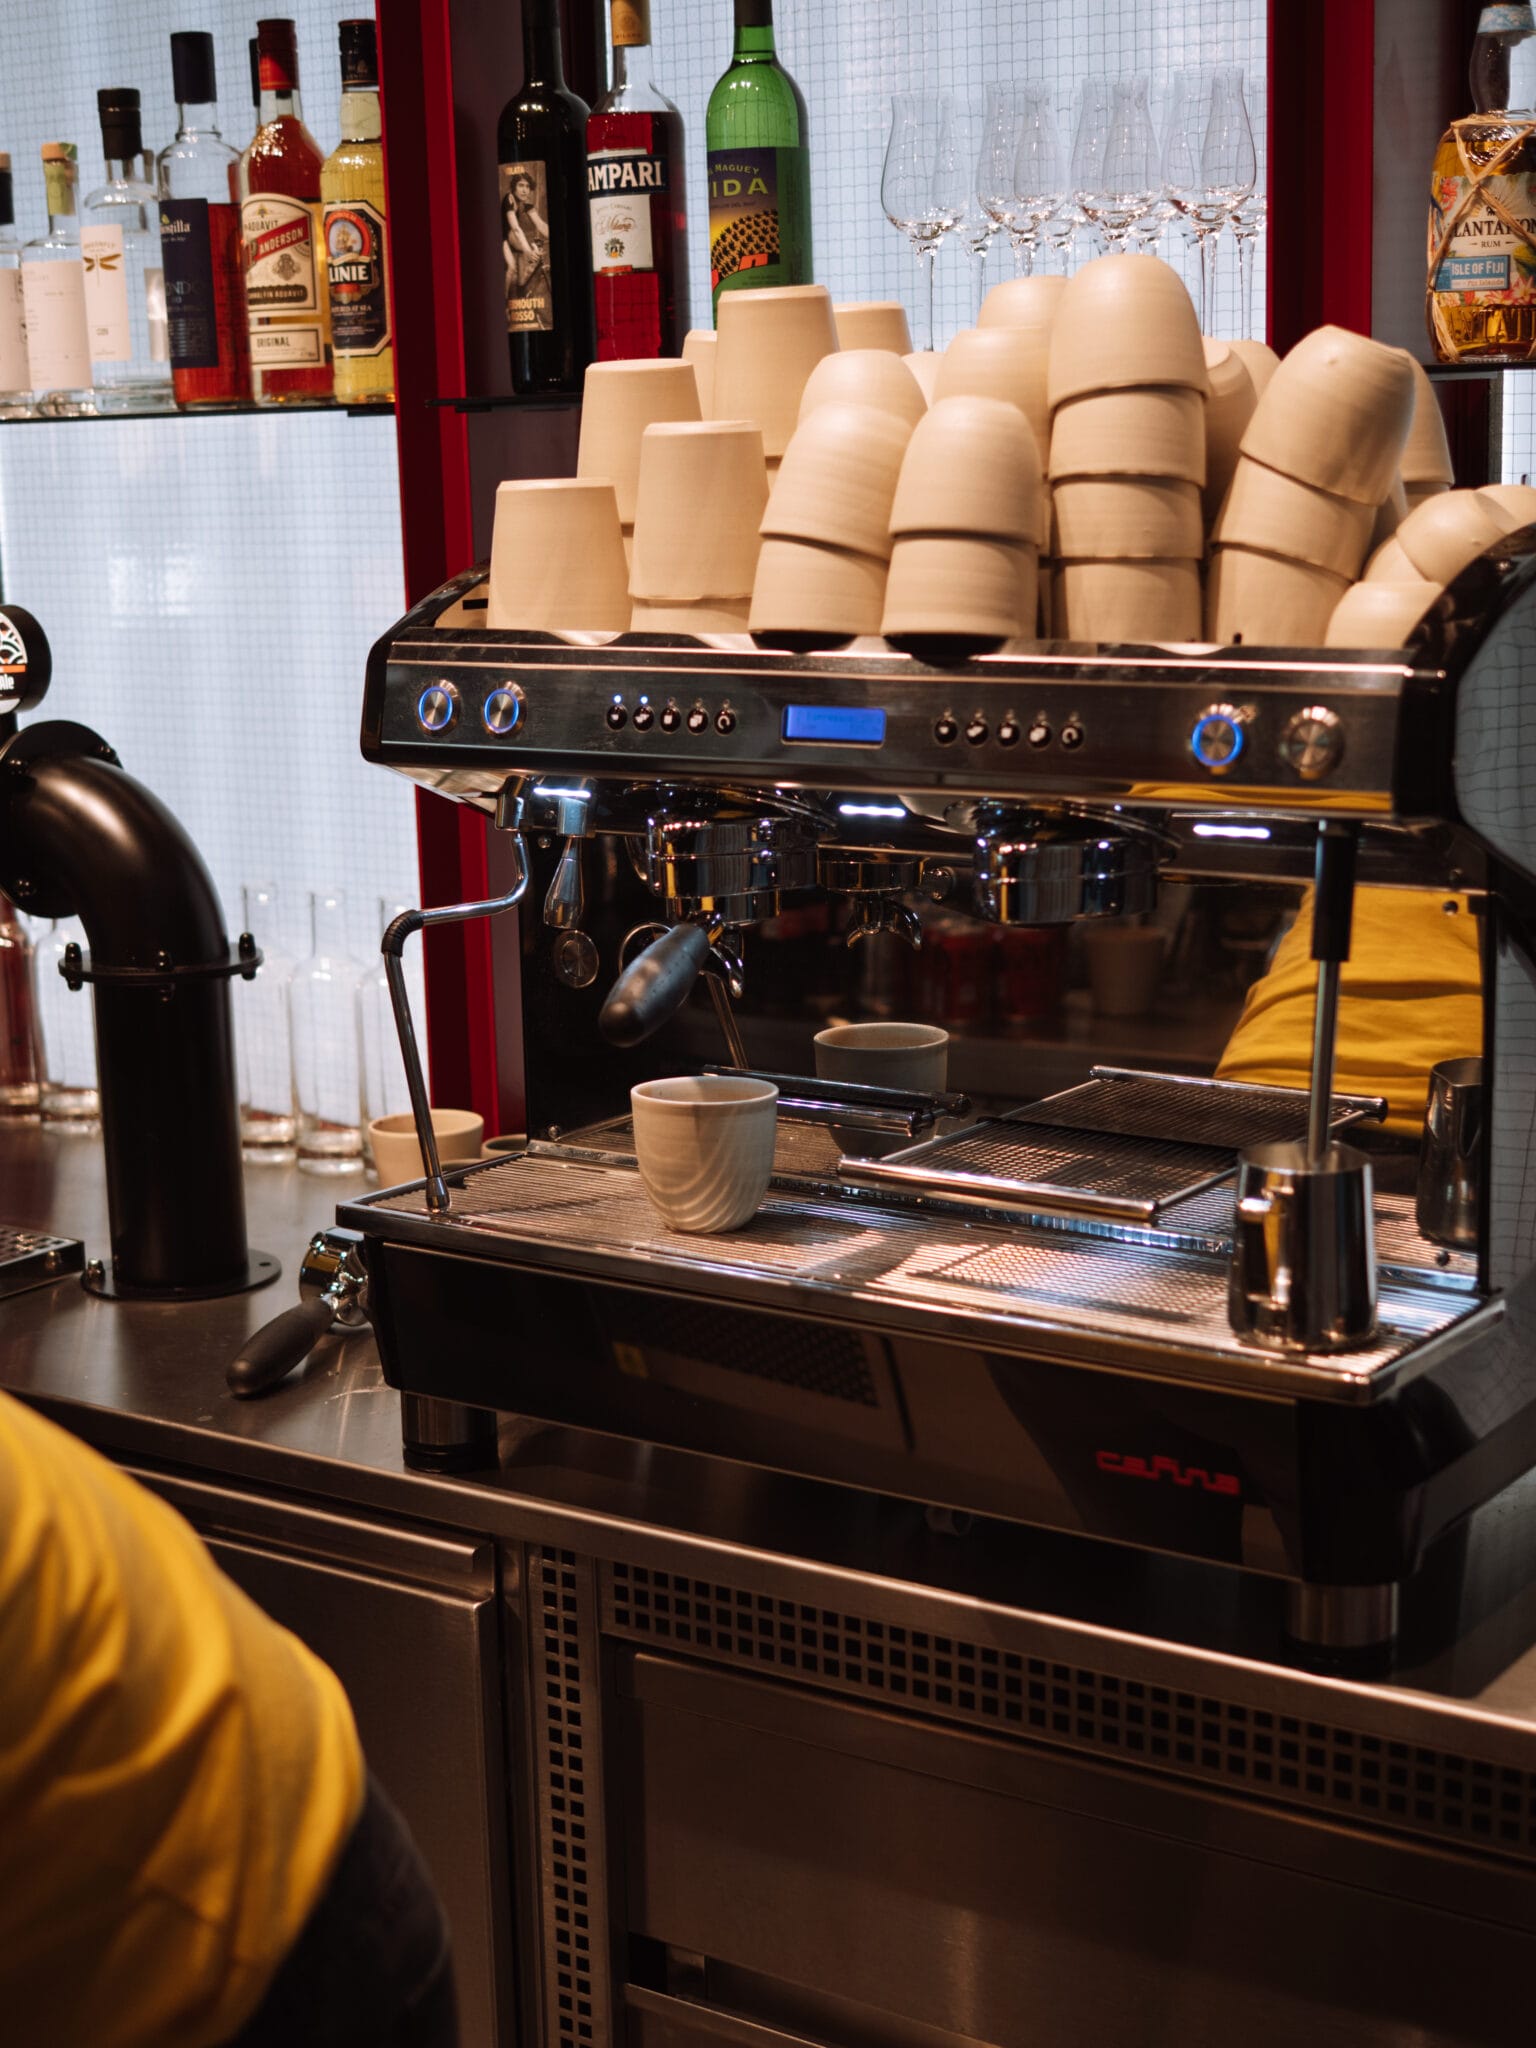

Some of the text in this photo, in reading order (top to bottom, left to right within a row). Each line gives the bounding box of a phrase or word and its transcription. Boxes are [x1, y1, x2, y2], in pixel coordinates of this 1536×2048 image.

[586, 161, 662, 192] AMPARI
[714, 163, 760, 175] MAGUEY
[711, 178, 769, 198] IDA
[259, 226, 304, 254] ANDERSON
[1480, 240, 1501, 249] RUM
[329, 265, 369, 283] LINIE
[1451, 260, 1504, 276] ISLE OF FIJI
